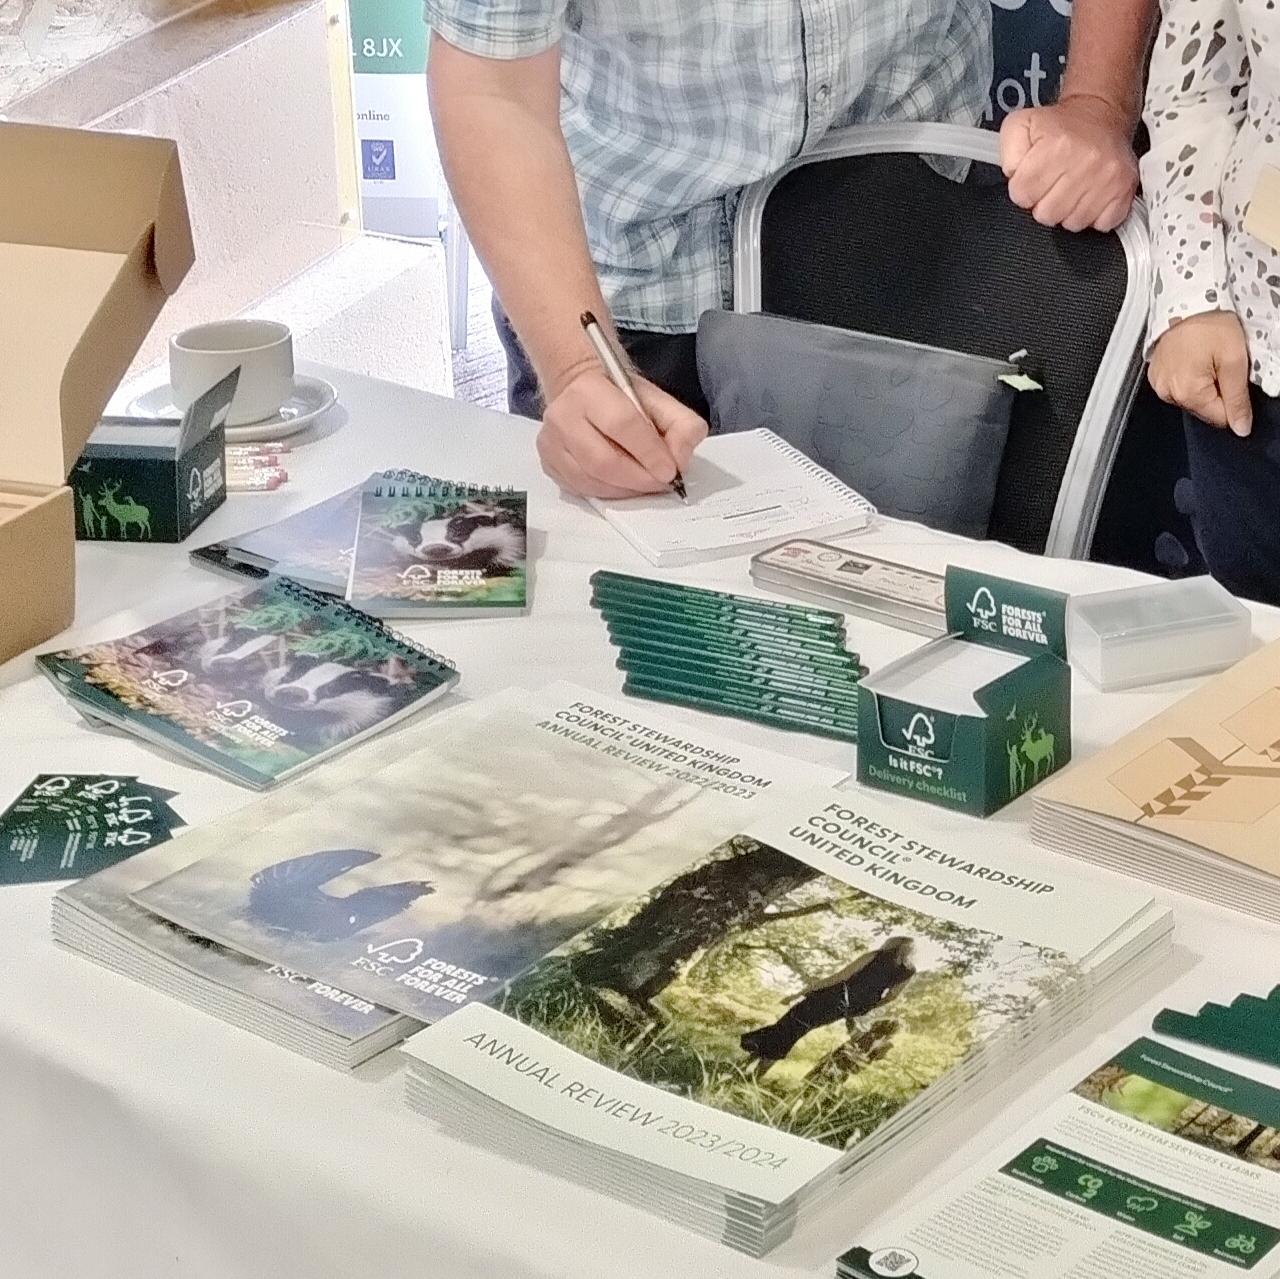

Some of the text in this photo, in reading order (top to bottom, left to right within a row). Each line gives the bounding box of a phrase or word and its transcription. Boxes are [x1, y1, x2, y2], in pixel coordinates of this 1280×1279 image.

[363, 38, 403, 58] 8JX
[973, 617, 997, 633] FSC
[1001, 615, 1043, 634] FOR ALL
[1002, 626, 1048, 645] FOREVER
[569, 701, 741, 766] FOREST STEWARDSHIP
[538, 721, 757, 801] ANNUAL REVIEW 2022/2023
[629, 738, 688, 764] UNITED
[686, 759, 772, 789] KINGDOM
[888, 754, 898, 768] Is
[900, 757, 908, 771] it
[868, 764, 967, 802] Delivery checklist
[788, 825, 979, 910] UNITED KINGDOM
[823, 803, 1055, 895] FOREST STEWARDSHIP
[351, 956, 394, 977] FSC
[408, 966, 474, 995] FOR ALL
[265, 963, 376, 1014] FSC FOREVER
[395, 973, 468, 1004] FOREVER
[463, 1031, 789, 1171] ANNUAL REVIEW 2023/2024
[1104, 1115, 1170, 1147] ECOSYSTEM
[1168, 1140, 1218, 1166] SERVICES
[1218, 1161, 1262, 1180] CLAIMS
